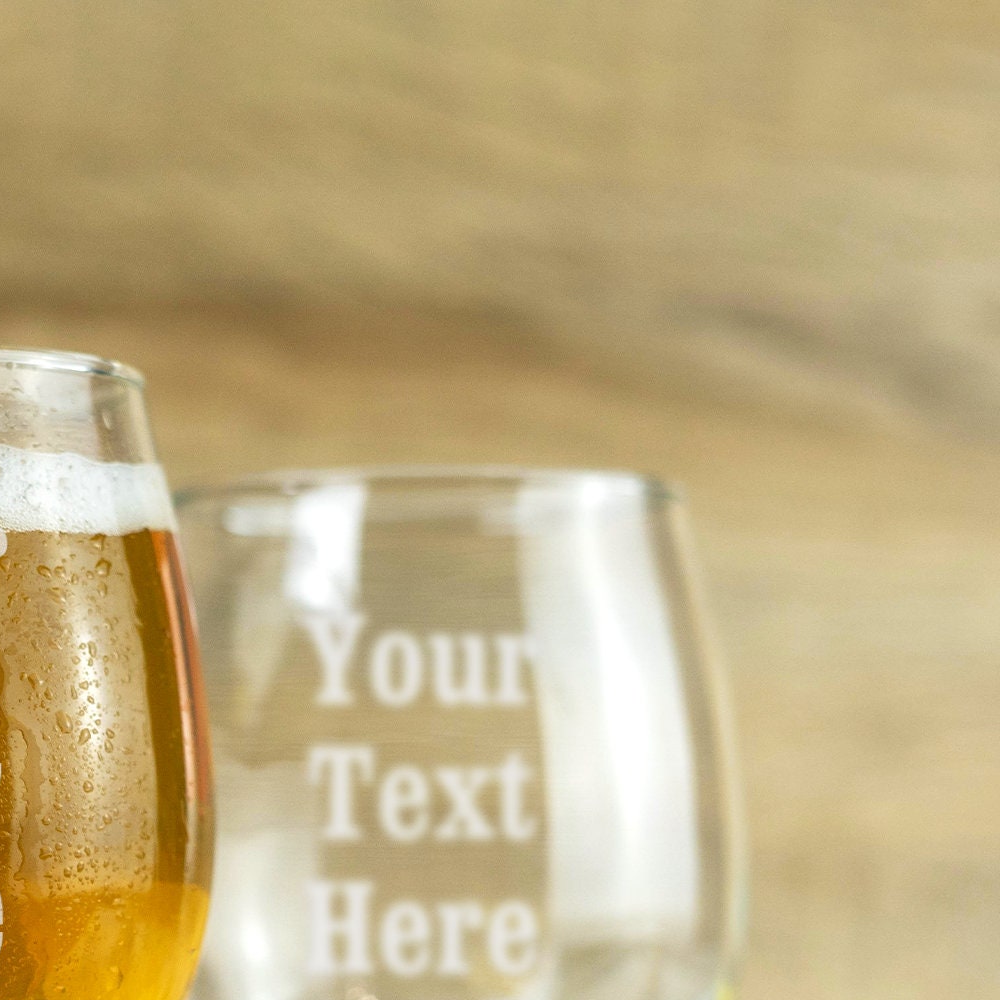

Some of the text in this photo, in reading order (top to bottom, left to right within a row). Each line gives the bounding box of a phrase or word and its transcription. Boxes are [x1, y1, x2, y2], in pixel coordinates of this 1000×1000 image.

[303, 611, 540, 706] Your
[306, 743, 537, 843] Text
[304, 878, 540, 978] Here
